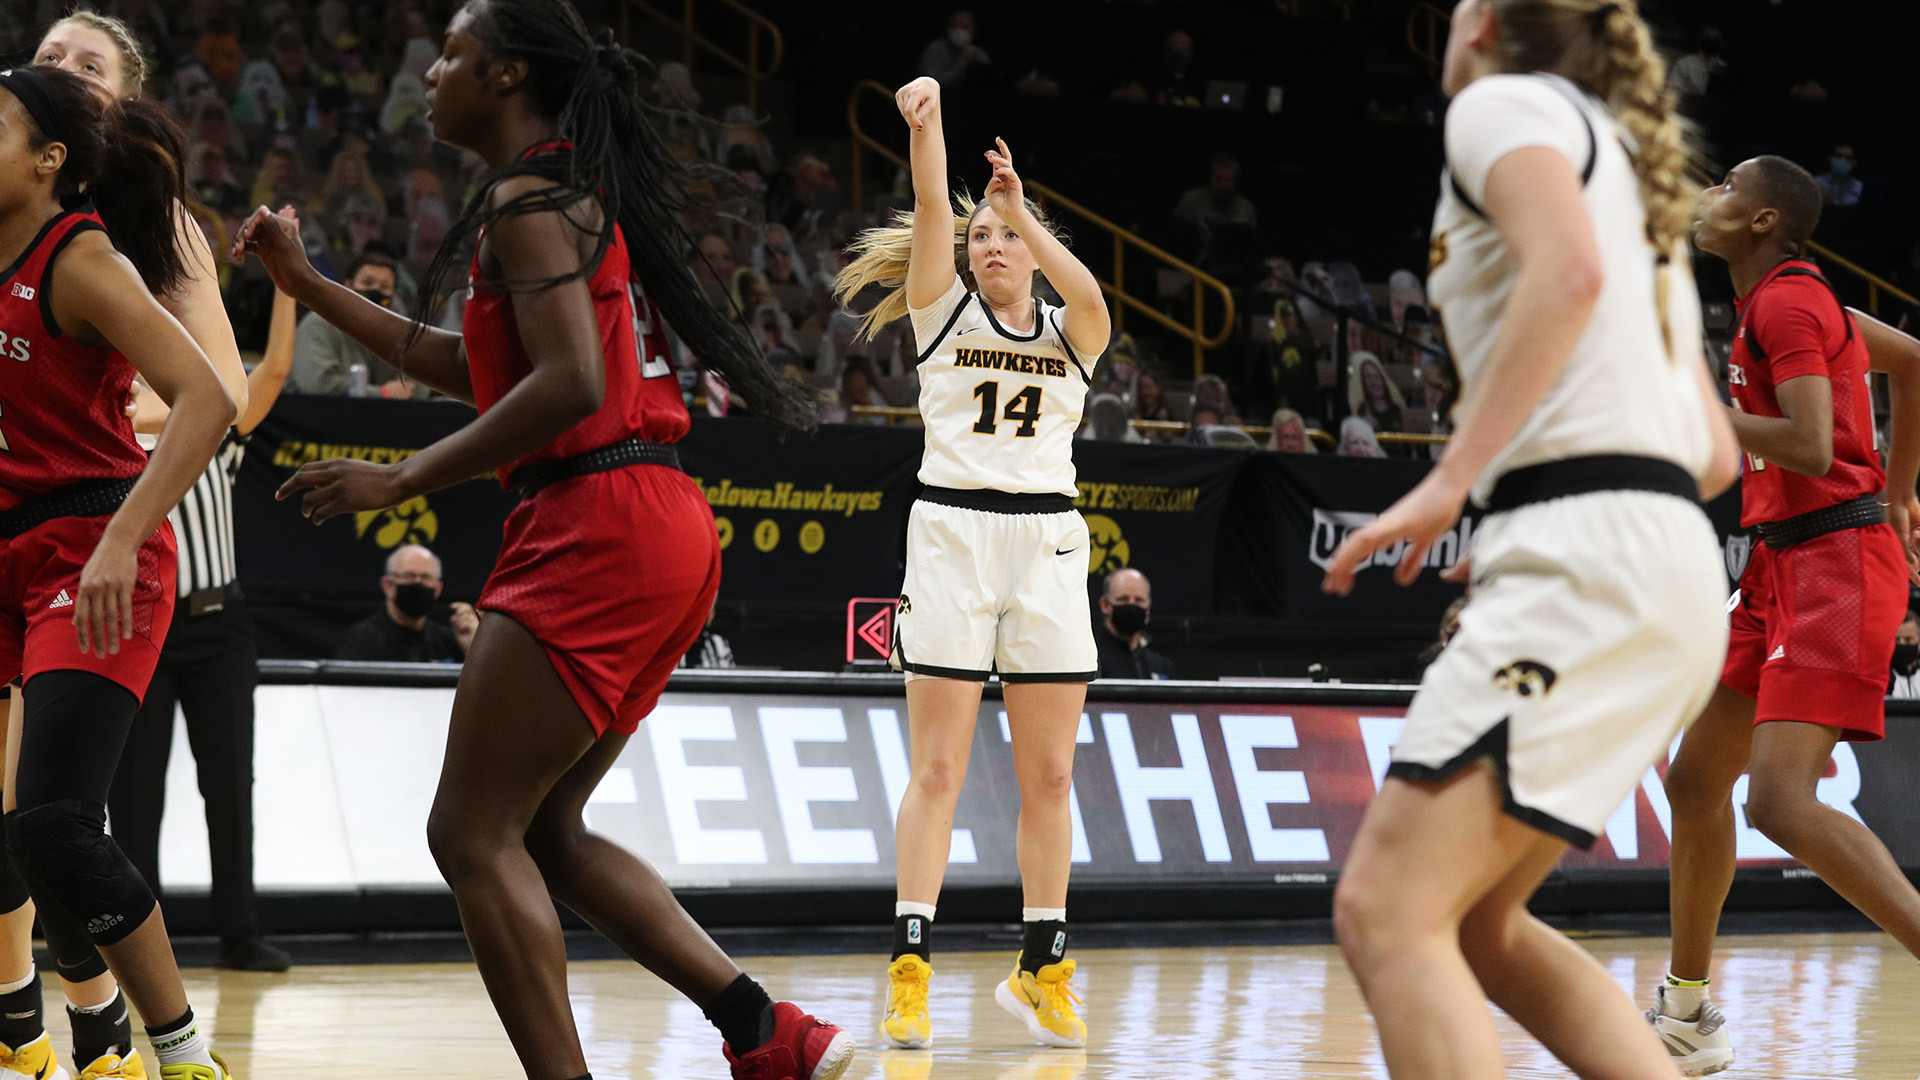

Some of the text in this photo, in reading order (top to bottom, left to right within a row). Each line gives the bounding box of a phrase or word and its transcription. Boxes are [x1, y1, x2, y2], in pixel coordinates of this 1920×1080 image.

[953, 348, 1067, 378] HAWKEYES
[972, 380, 1043, 438] 14
[273, 441, 420, 467] HAWKEY
[690, 478, 884, 517] heIowaHawkeyes
[1073, 481, 1200, 513] EYESPORTS.COM
[88, 914, 124, 933] adidas
